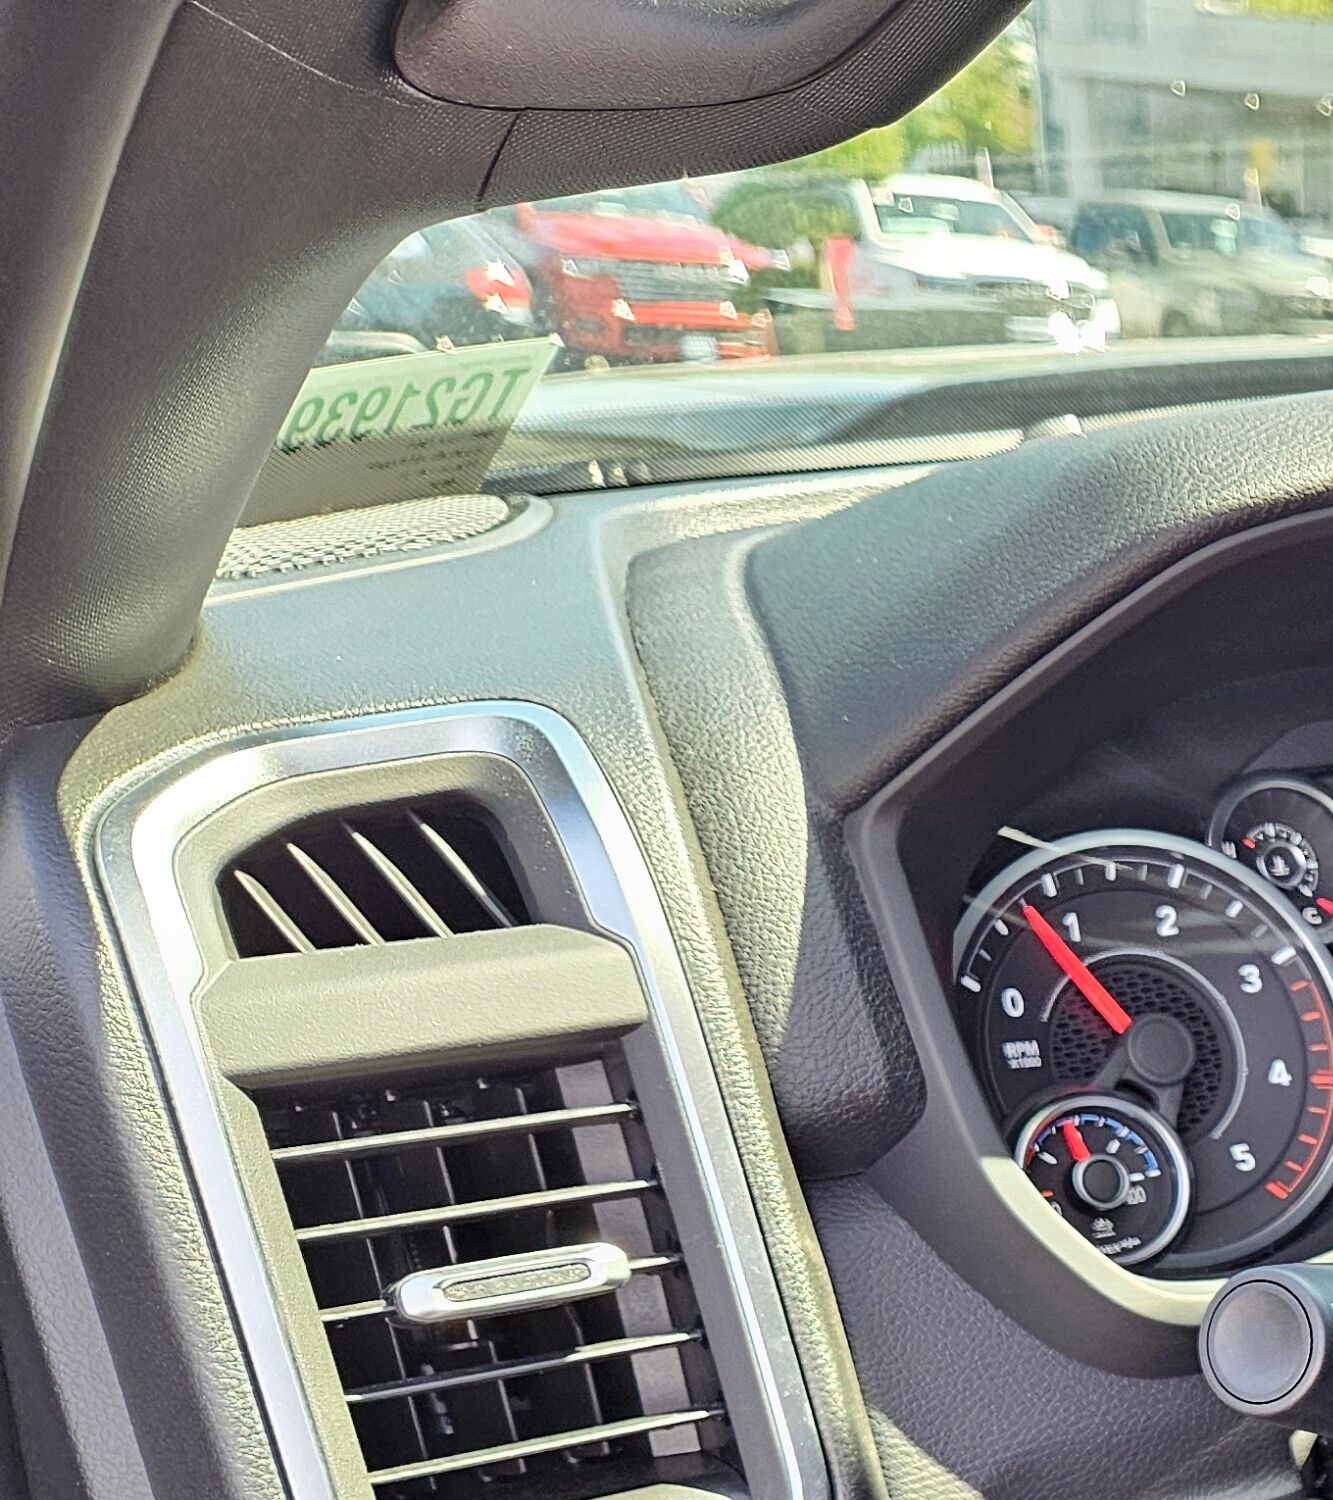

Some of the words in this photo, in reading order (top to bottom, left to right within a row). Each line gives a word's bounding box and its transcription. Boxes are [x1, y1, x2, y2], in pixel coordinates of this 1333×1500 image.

[1062, 911, 1083, 943] 1
[1154, 905, 1181, 938] 2
[1301, 906, 1323, 925] C
[1237, 964, 1263, 995] 3
[1001, 986, 1025, 1018] 0
[1003, 1040, 1040, 1058] RPM
[1267, 1058, 1293, 1087] 4
[1229, 1144, 1257, 1172] 5
